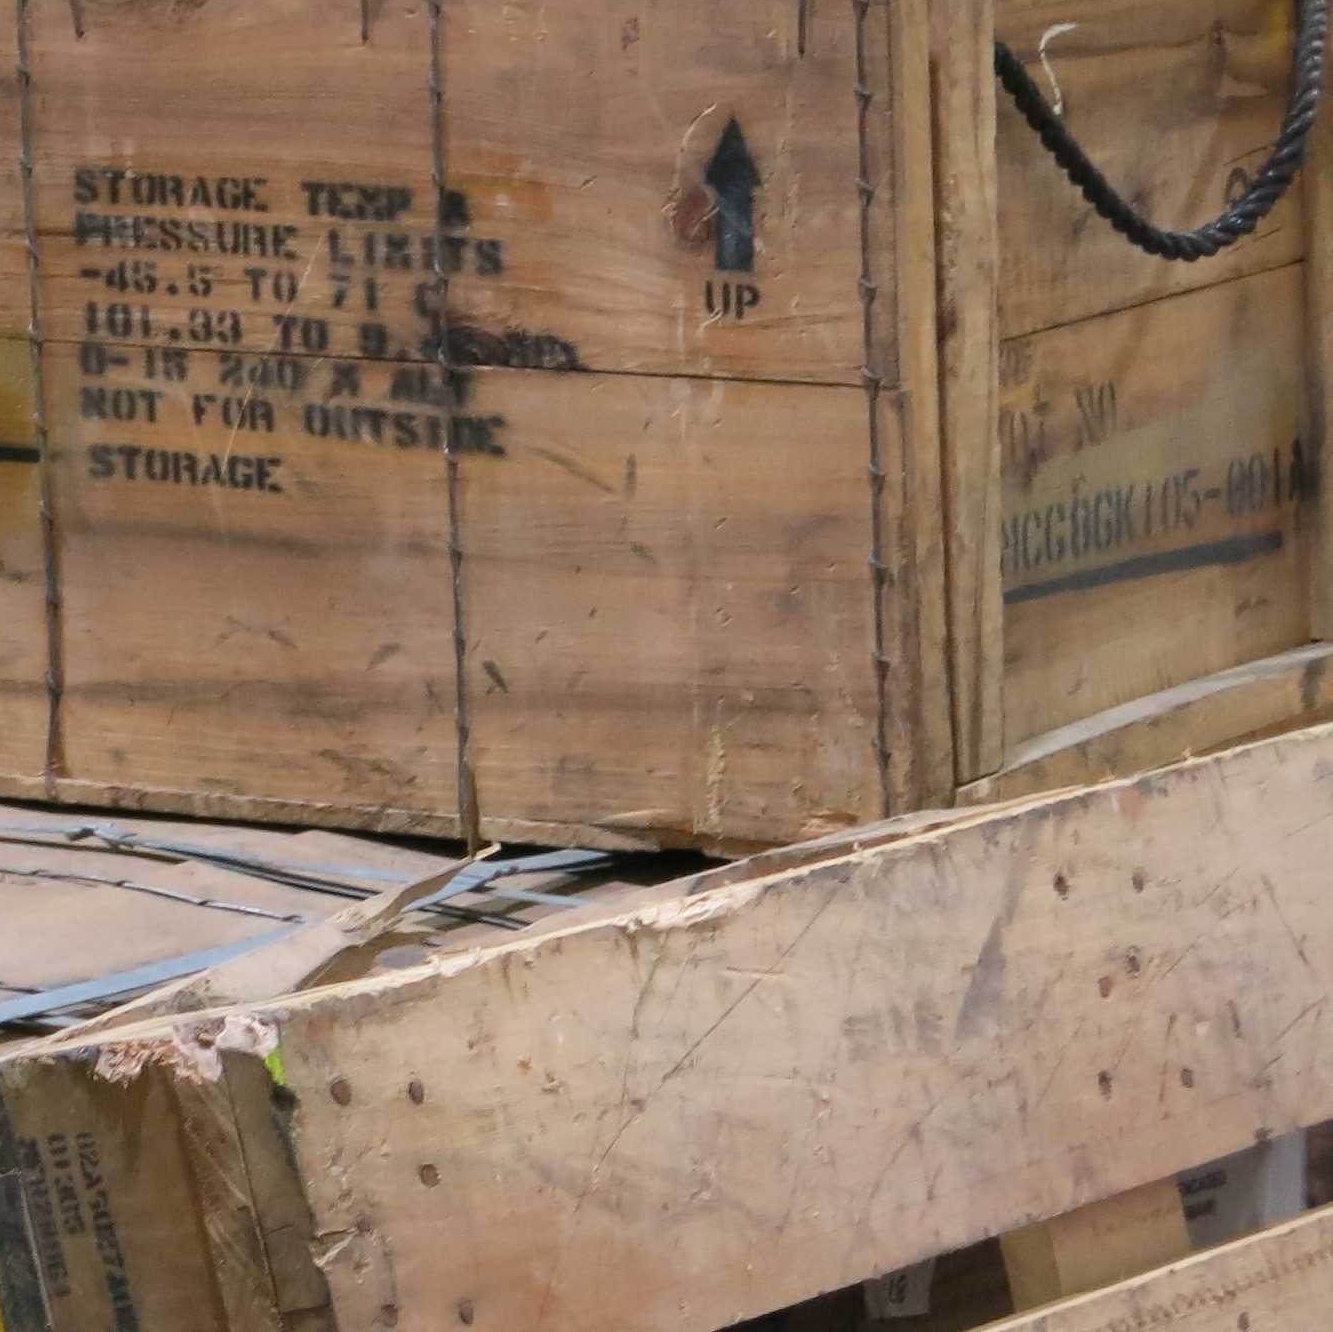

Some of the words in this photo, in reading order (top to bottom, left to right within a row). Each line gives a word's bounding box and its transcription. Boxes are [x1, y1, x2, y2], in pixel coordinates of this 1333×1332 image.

[75, 169, 268, 212] STORAGE
[301, 180, 412, 220] TEMP
[75, 213, 299, 260] PRESSURE
[328, 229, 504, 276] LIMITS
[244, 267, 299, 303] TO
[328, 274, 378, 310] 71
[705, 279, 763, 319] UP
[273, 314, 329, 351] TO
[79, 386, 163, 422] NOT
[193, 393, 274, 433] FOR
[303, 403, 507, 458] OUTSIDE
[89, 443, 283, 493] STORAGE
